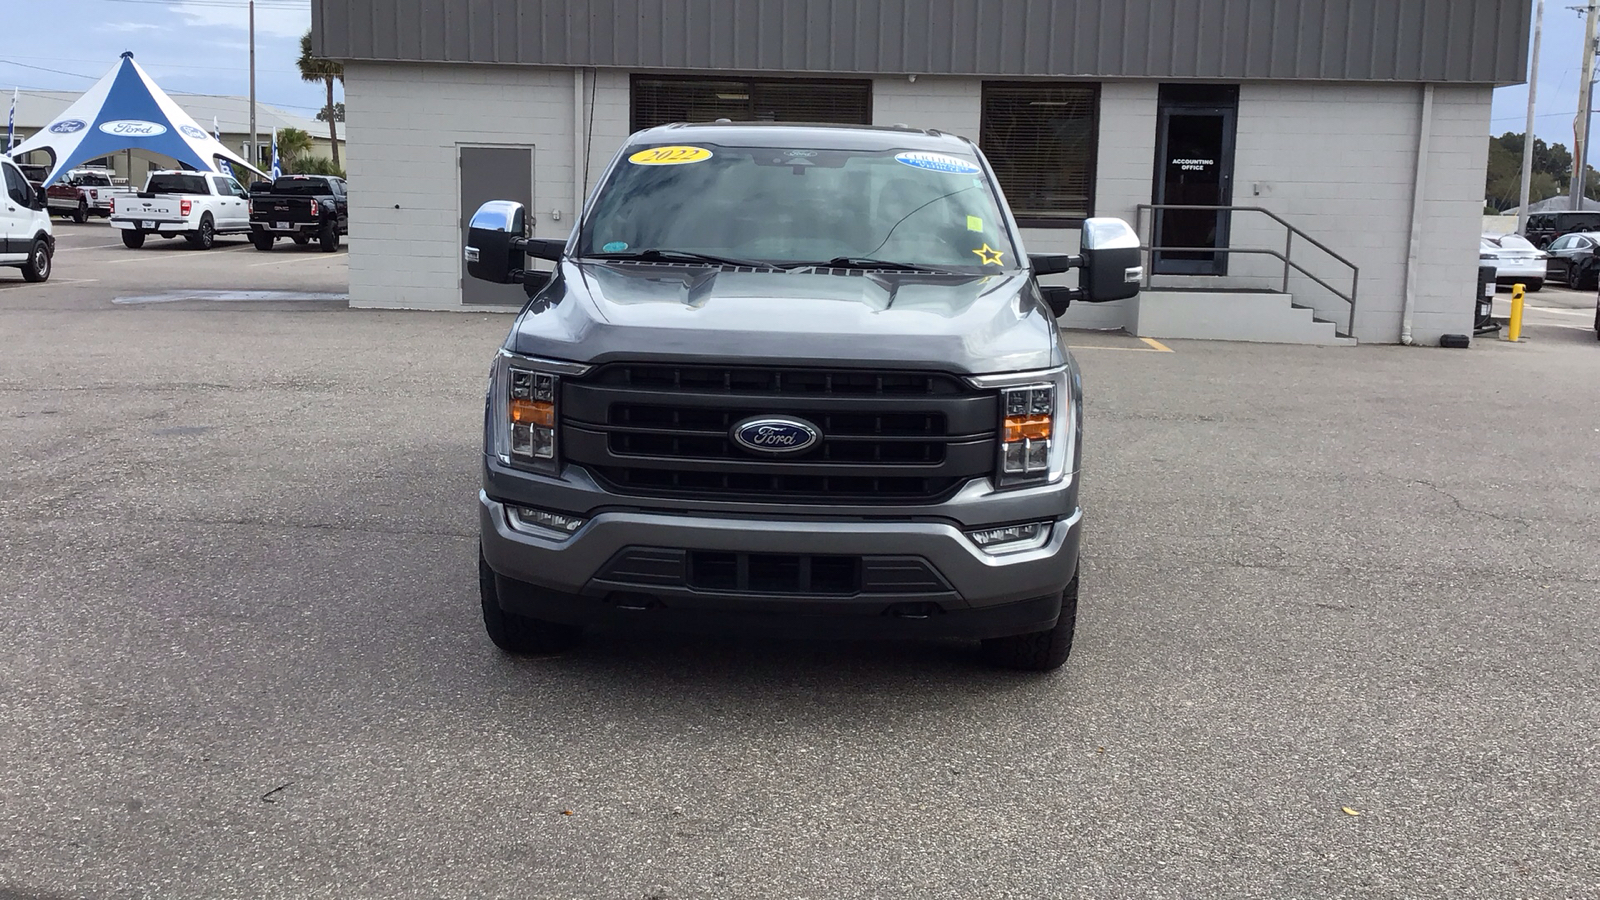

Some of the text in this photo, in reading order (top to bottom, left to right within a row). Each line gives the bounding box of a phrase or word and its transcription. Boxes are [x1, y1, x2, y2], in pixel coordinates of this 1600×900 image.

[113, 122, 153, 134] Ford
[641, 149, 700, 162] 2022
[753, 426, 797, 445] Ford
